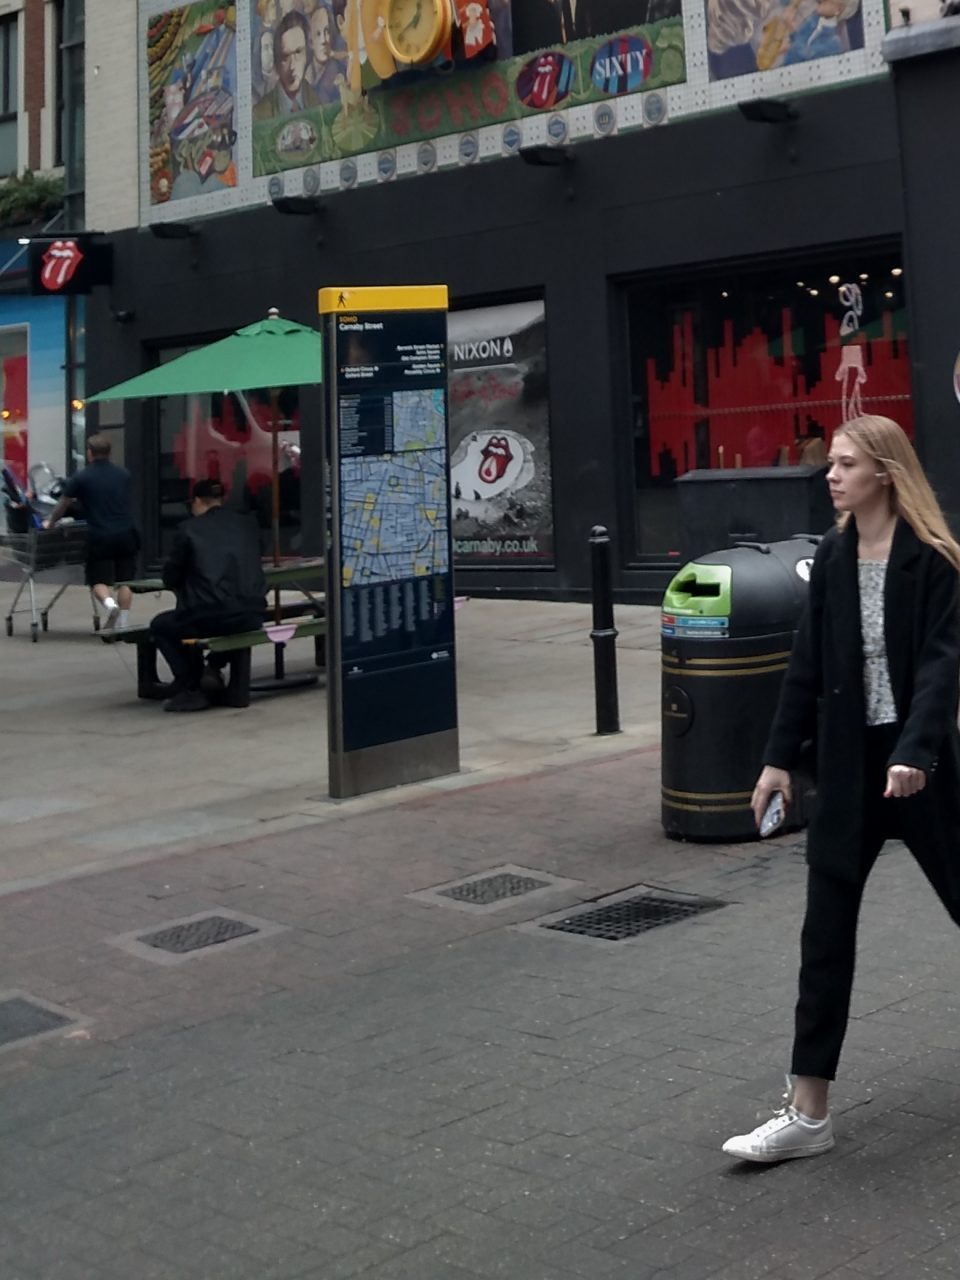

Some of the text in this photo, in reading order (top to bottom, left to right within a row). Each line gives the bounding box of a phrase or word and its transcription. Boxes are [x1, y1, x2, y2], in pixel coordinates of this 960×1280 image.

[595, 52, 648, 80] SIXTY
[390, 73, 508, 137] SOHO
[339, 322, 384, 331] Carnaby Street
[454, 339, 501, 361] NIXON
[452, 537, 538, 556] carnaby.co.uk
